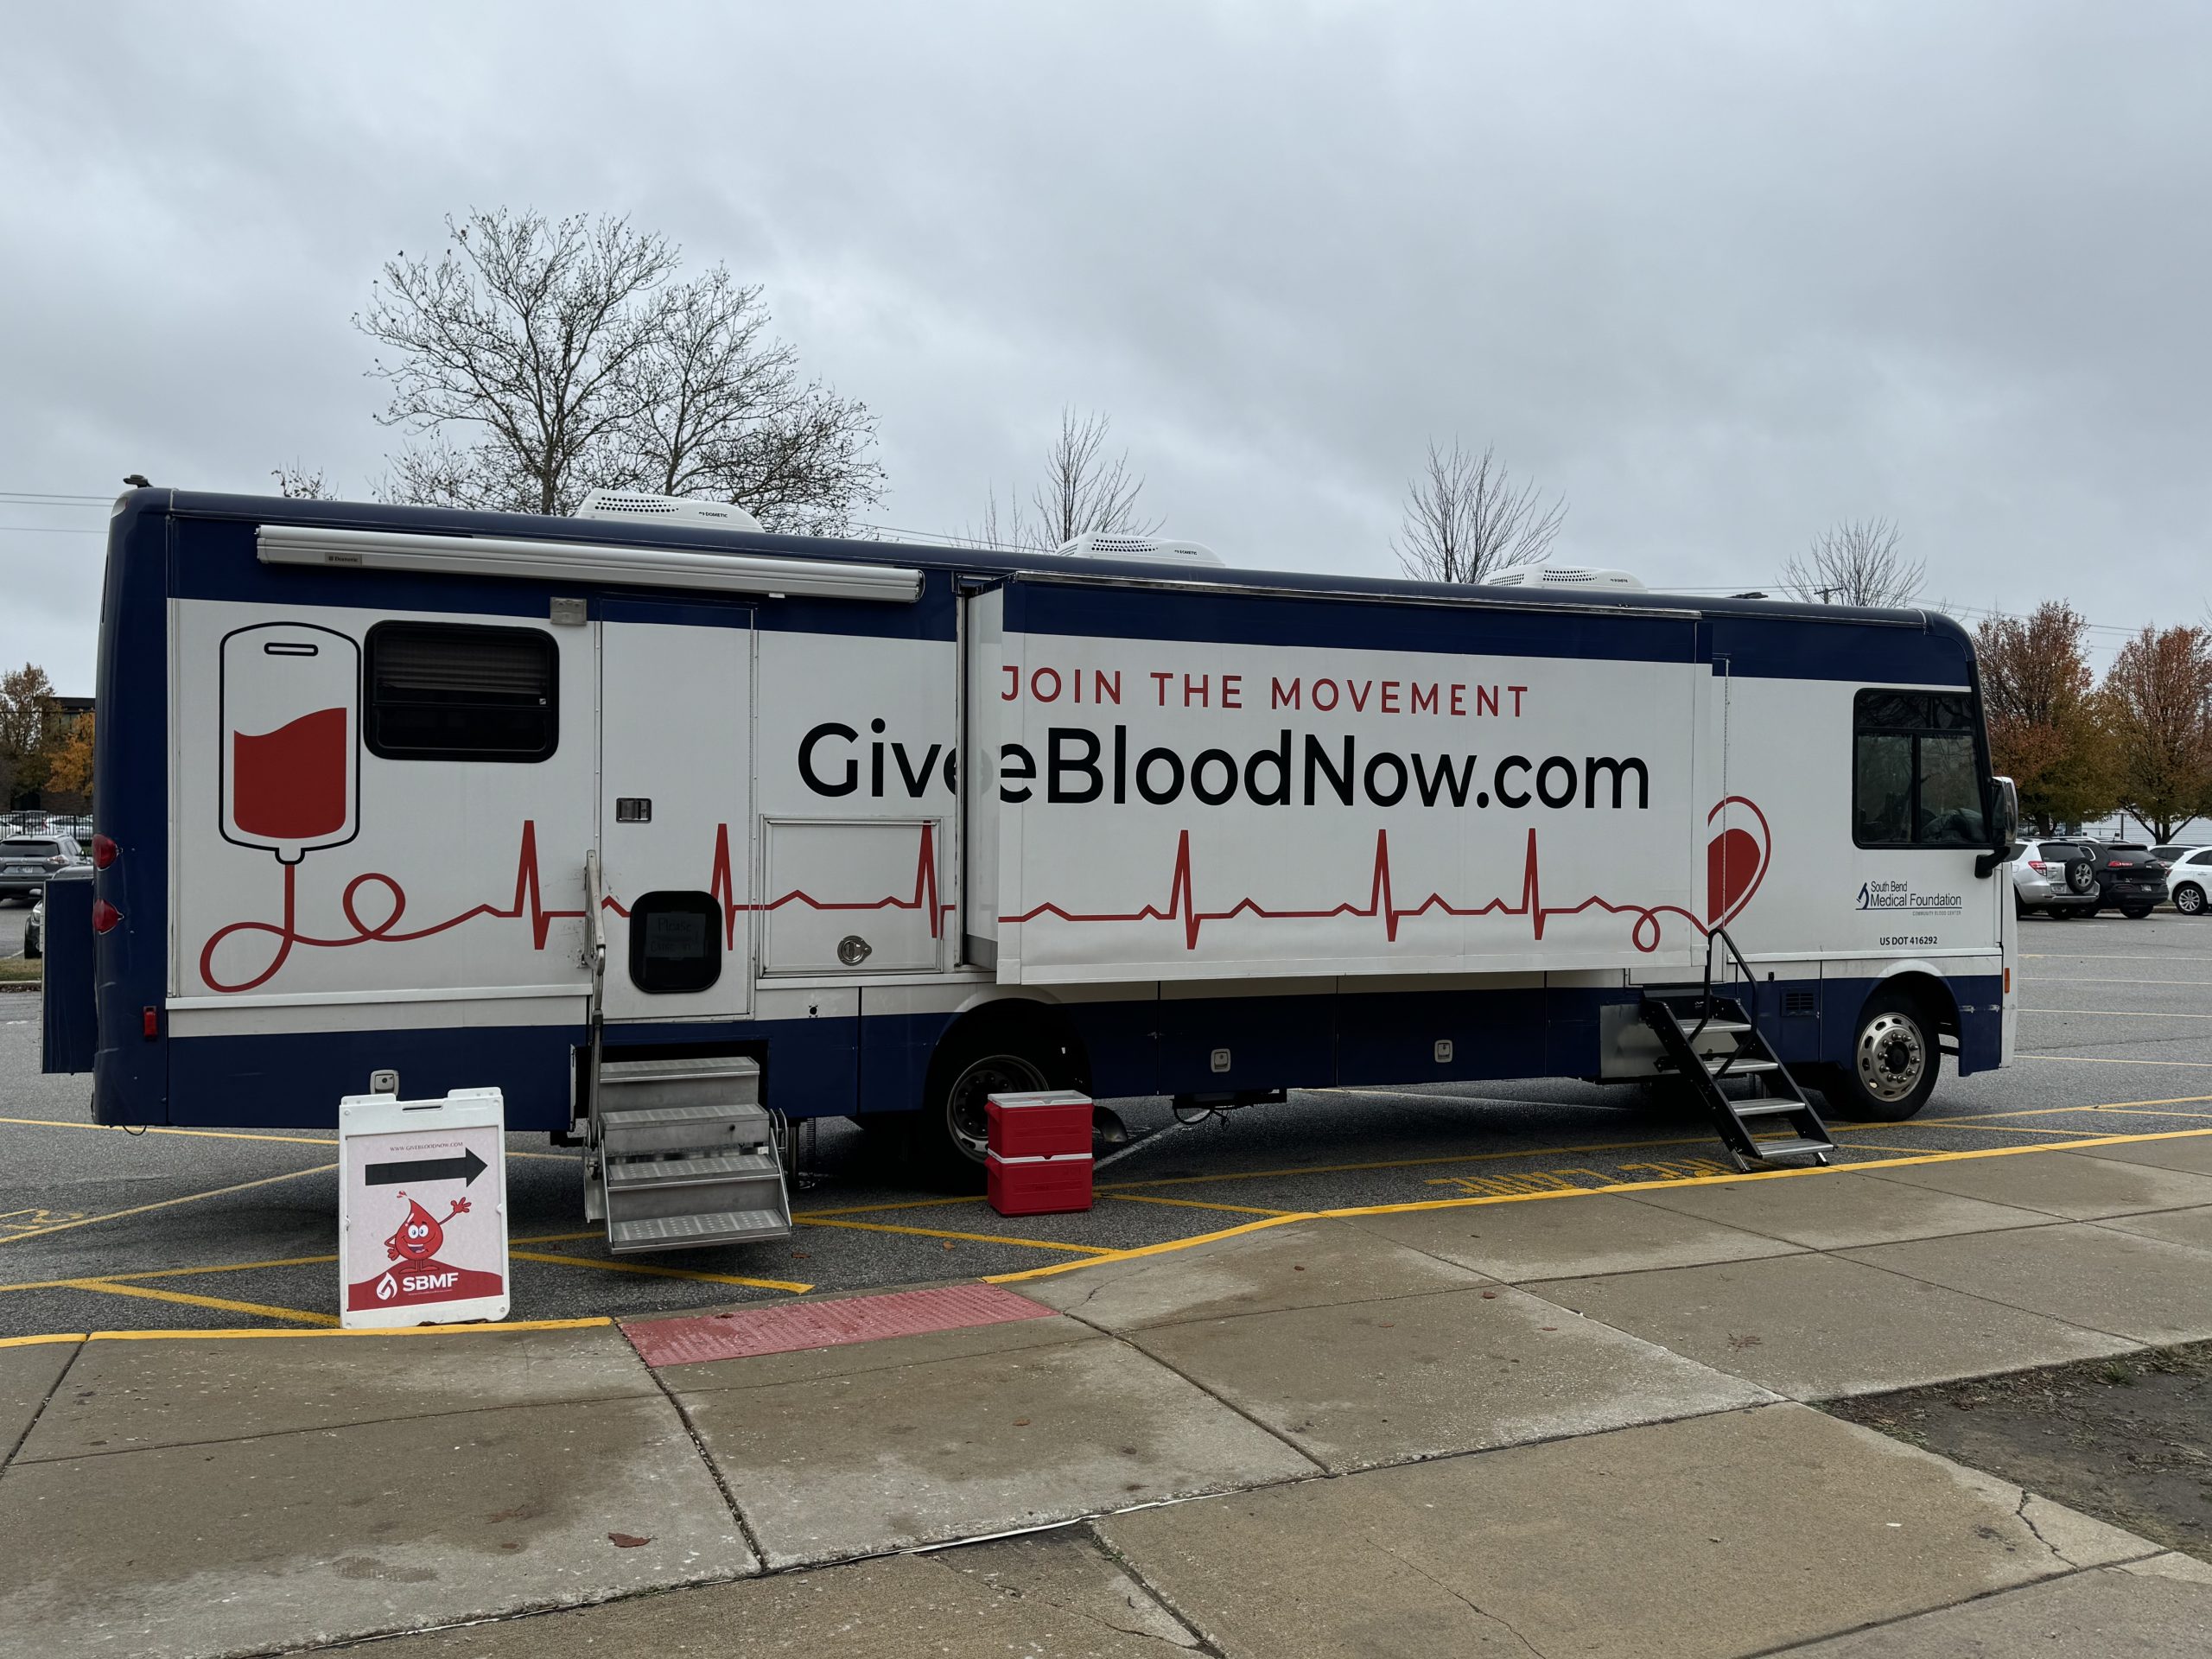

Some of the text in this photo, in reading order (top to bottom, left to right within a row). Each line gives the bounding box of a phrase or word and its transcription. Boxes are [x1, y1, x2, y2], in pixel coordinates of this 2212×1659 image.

[1002, 666, 1529, 716] JOIN THE MOVEMENT
[1871, 880, 1908, 893] South Bend
[1871, 893, 1961, 907] Medical Foundation
[1879, 936, 1938, 946] US DOT 416292
[402, 1272, 459, 1292] SBMF
